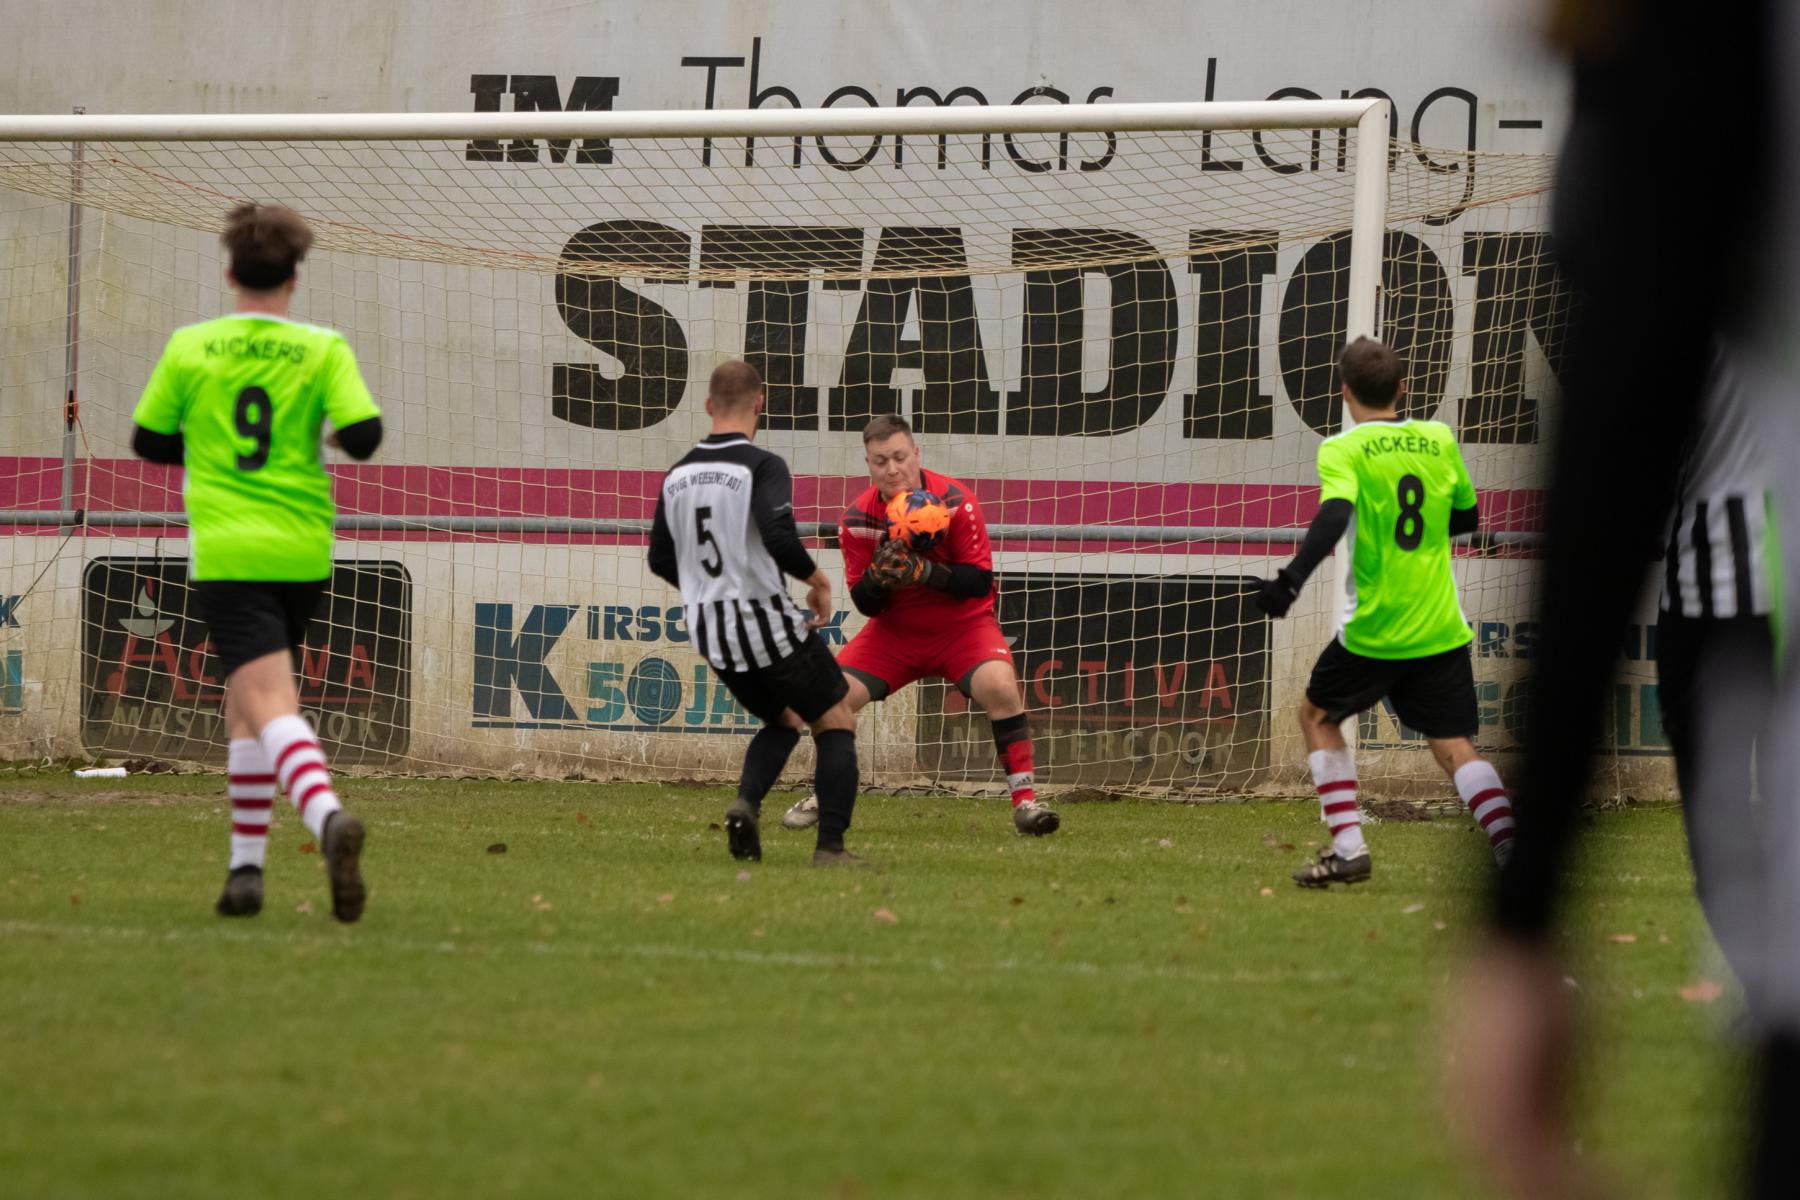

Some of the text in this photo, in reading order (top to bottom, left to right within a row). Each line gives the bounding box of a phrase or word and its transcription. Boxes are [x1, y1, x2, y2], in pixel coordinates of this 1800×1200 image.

[466, 74, 620, 164] IM
[681, 37, 1116, 172] Thomas
[204, 336, 306, 364] KICKERS
[235, 385, 272, 471] 9
[1361, 436, 1441, 458] KICKERS
[695, 506, 723, 578] 5
[1395, 474, 1424, 551] 8
[106, 632, 374, 699] ACVA
[951, 725, 1237, 768] MTERCOOK
